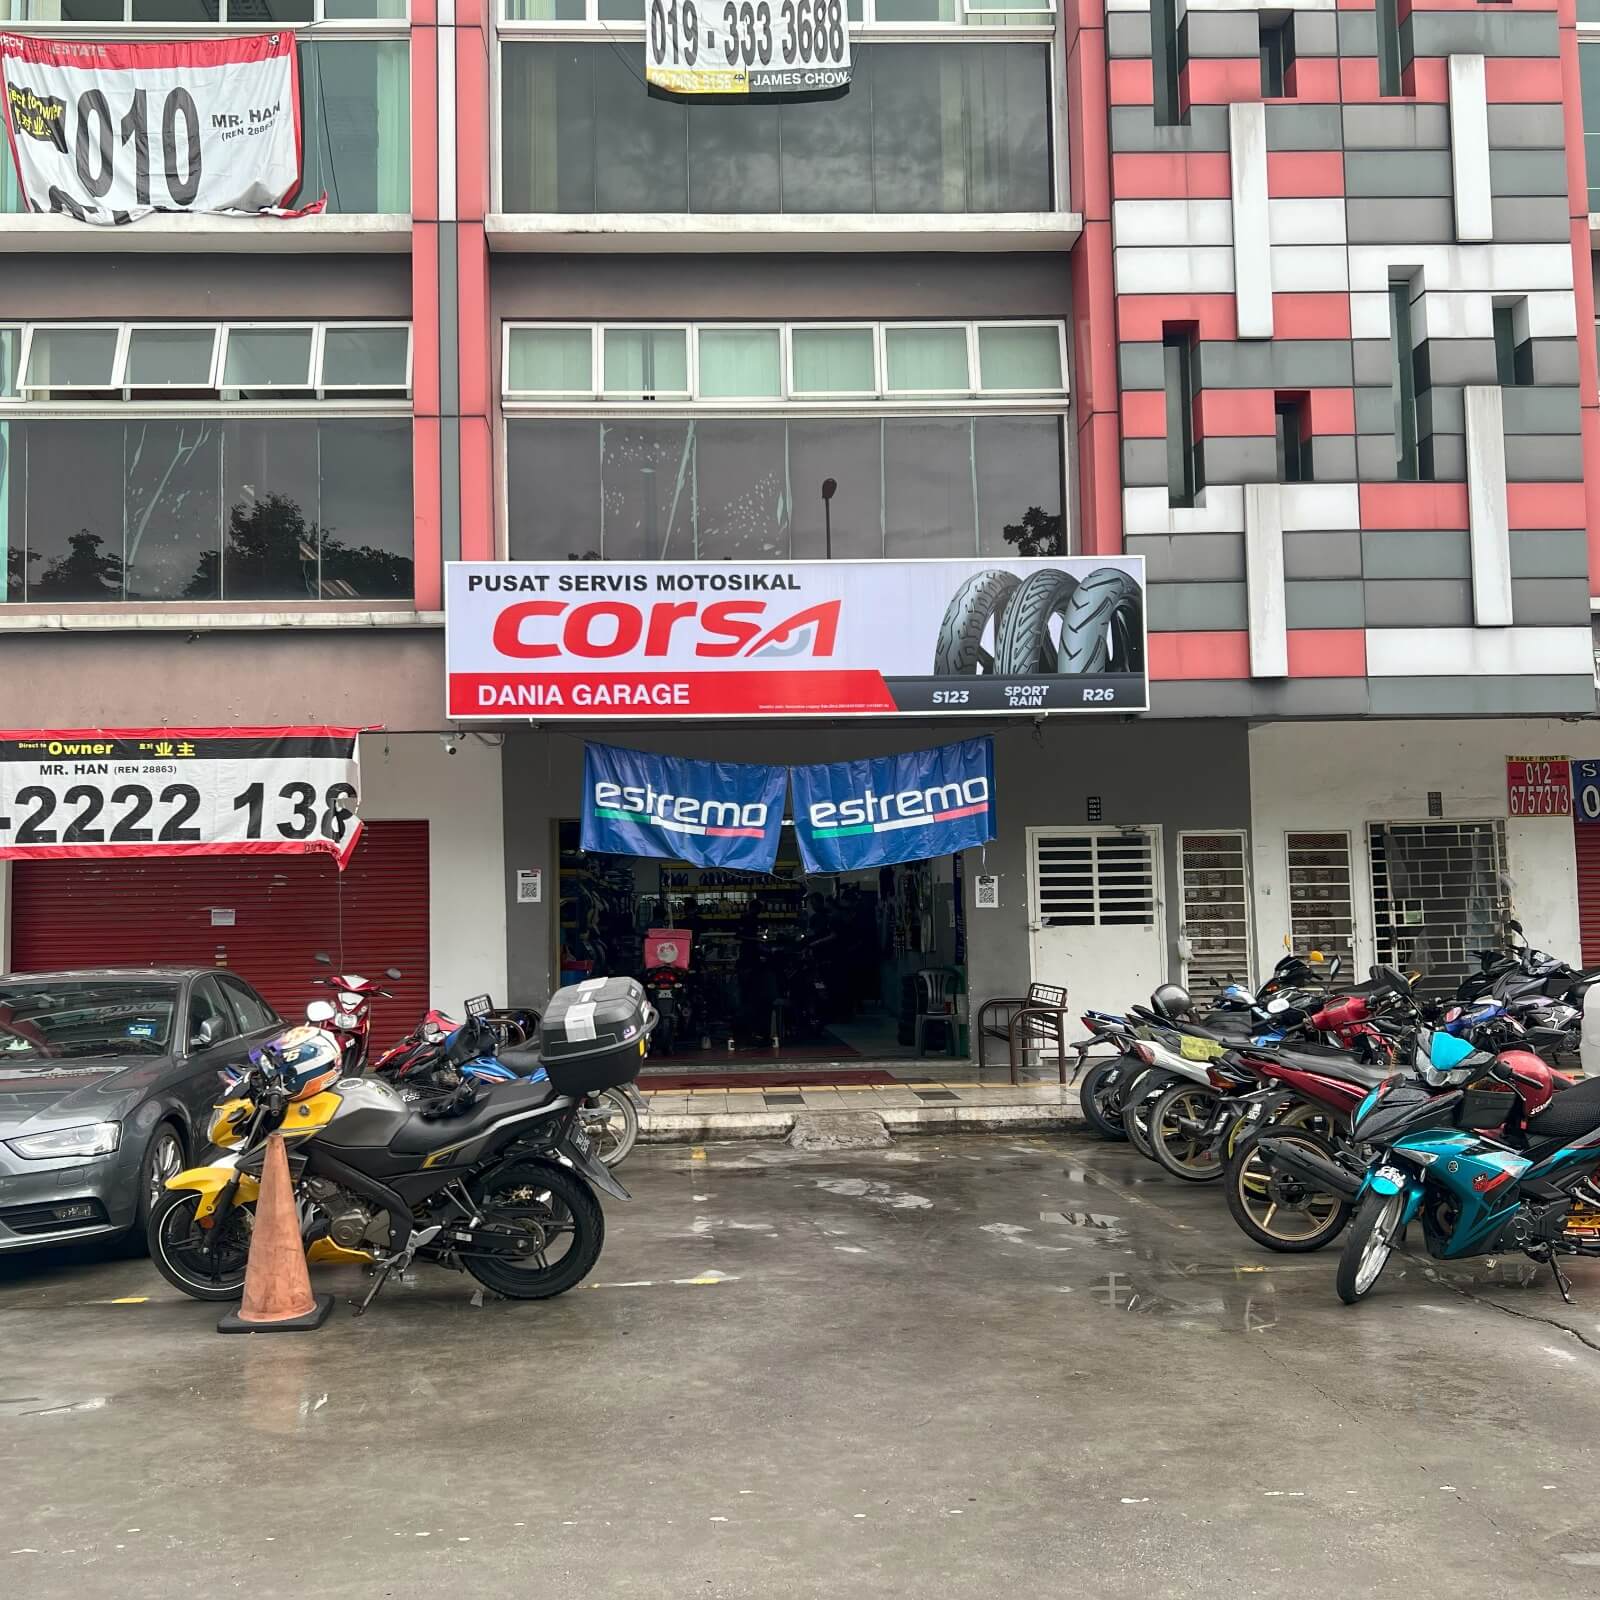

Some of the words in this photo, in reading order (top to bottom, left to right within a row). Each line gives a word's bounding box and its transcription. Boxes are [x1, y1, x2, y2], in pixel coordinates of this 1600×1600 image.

[651, 0, 698, 66] 019
[723, 1, 773, 66] 333
[781, 0, 844, 64] 3688
[753, 73, 801, 87] JAMES
[804, 71, 848, 84] CHOW
[211, 114, 244, 128] MR.
[248, 101, 281, 123] HAN
[221, 127, 244, 142] (REN
[75, 87, 202, 206] 010
[468, 575, 549, 592] PUSAT
[558, 574, 648, 592] SERVIS
[656, 573, 801, 592] MOTOSIKAL
[478, 684, 564, 706] DANIA
[572, 683, 690, 705] GARAGE
[932, 690, 970, 704] S123
[1004, 685, 1049, 697] SPORT
[1082, 688, 1114, 702] R26
[1009, 695, 1042, 707] RAIN
[48, 741, 114, 756] Owner
[39, 764, 69, 775] MR.
[74, 764, 108, 775] HAN
[114, 766, 139, 775] (REN
[142, 765, 177, 775] 28863)
[1526, 763, 1552, 784] 012
[595, 781, 768, 828] estremo
[809, 776, 989, 828] estremo
[1510, 785, 1569, 814] 6757373
